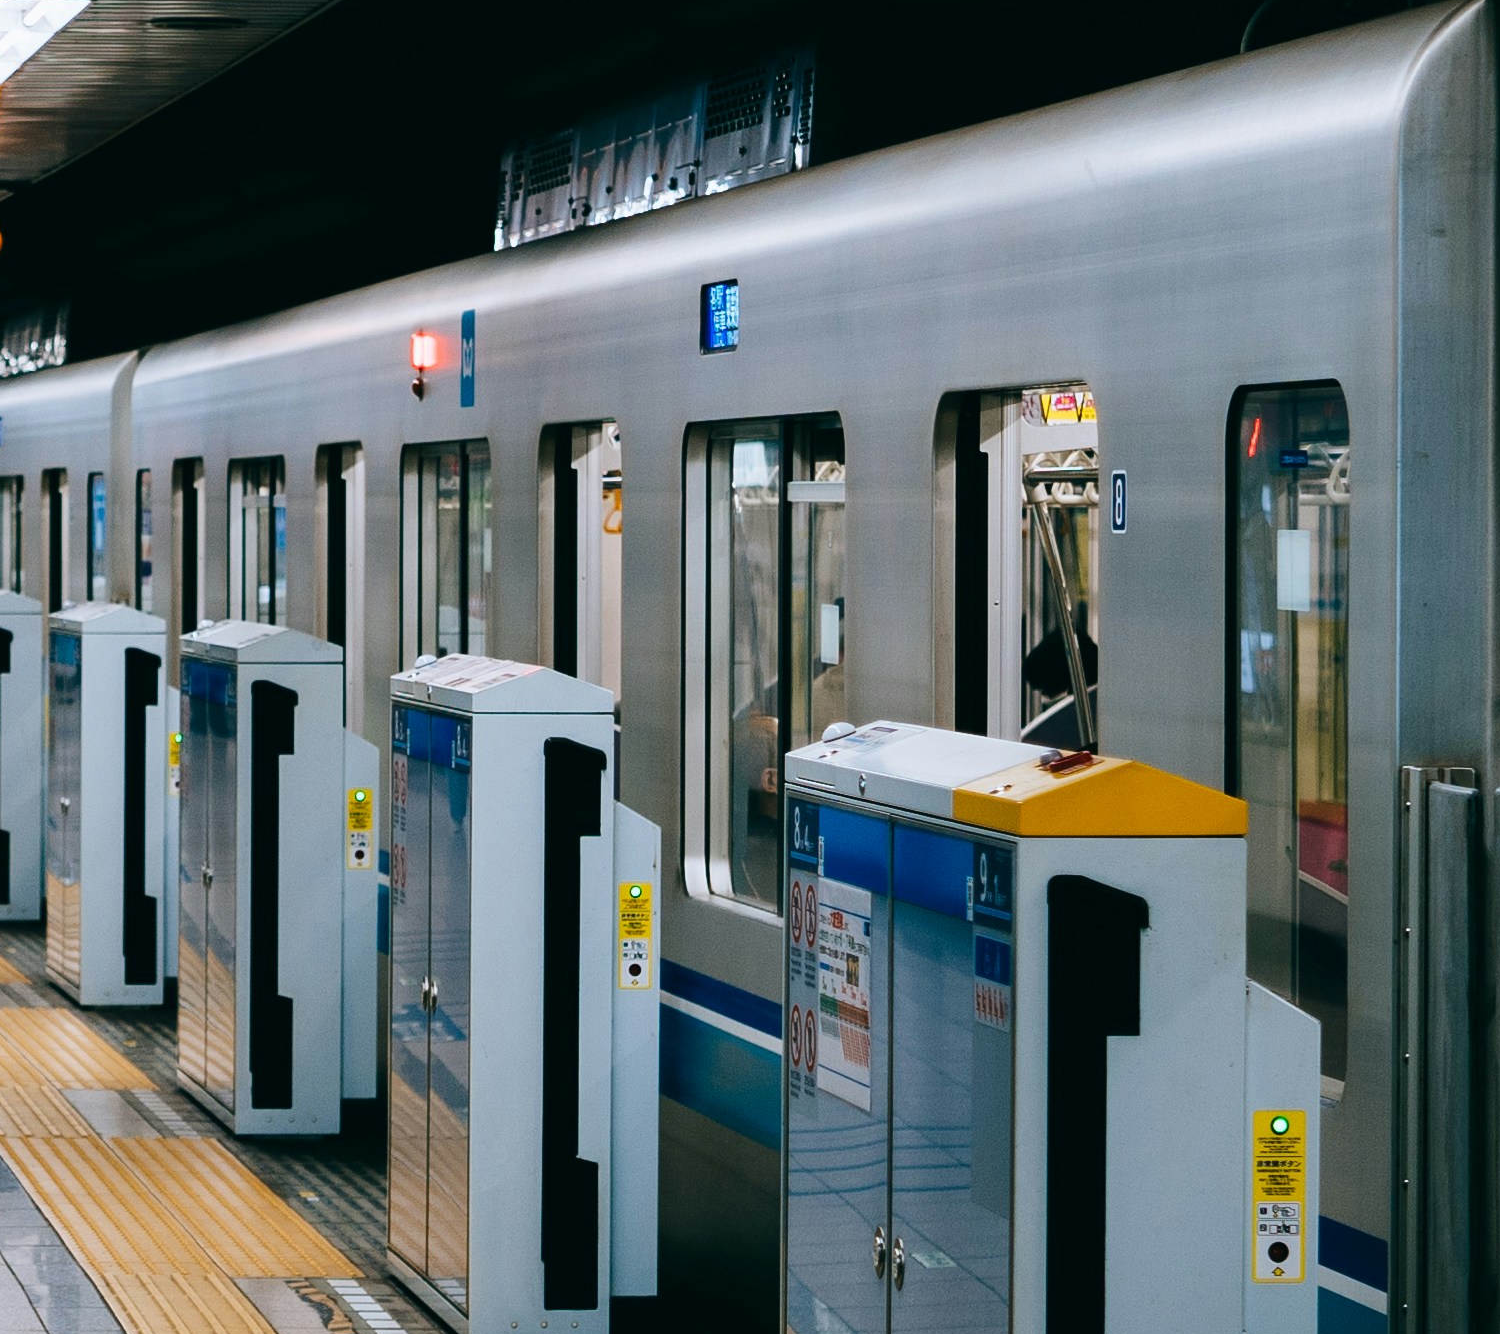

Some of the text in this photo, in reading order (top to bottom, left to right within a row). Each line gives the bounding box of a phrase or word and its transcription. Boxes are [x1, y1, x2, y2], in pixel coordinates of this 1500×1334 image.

[1114, 479, 1124, 529] 8
[793, 805, 802, 851] 8
[979, 852, 988, 903] 9
[1256, 1159, 1302, 1168] 非常開ボタン
